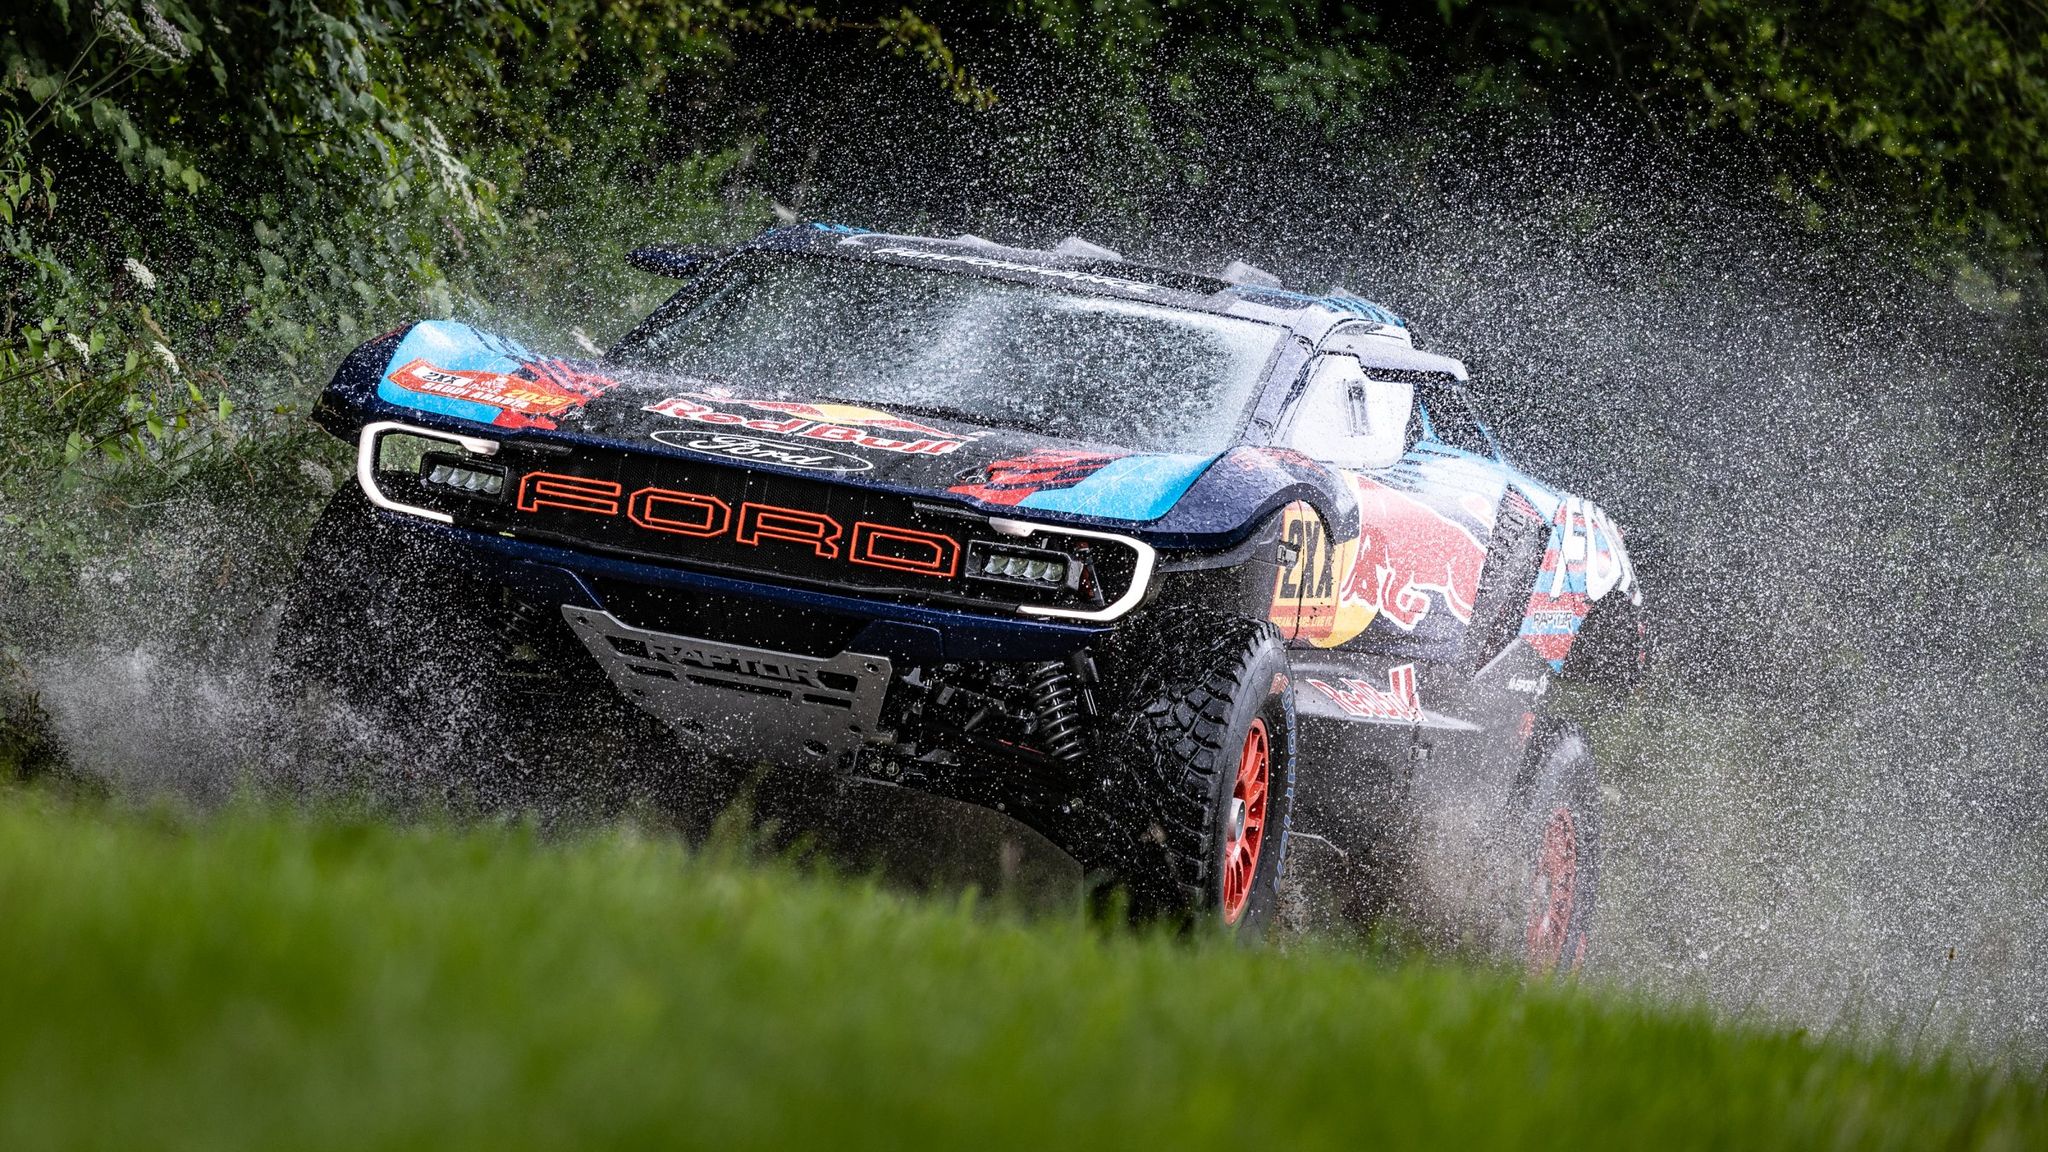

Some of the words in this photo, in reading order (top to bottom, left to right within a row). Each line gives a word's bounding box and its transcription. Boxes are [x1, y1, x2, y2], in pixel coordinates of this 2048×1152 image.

[421, 383, 468, 397] SAUDI
[469, 391, 531, 409] ARABIA
[422, 371, 460, 385] 2XX
[688, 435, 835, 466] Ford
[517, 470, 961, 578] FORD
[1279, 519, 1337, 599] 2XX
[644, 638, 829, 691] RAPTOR
